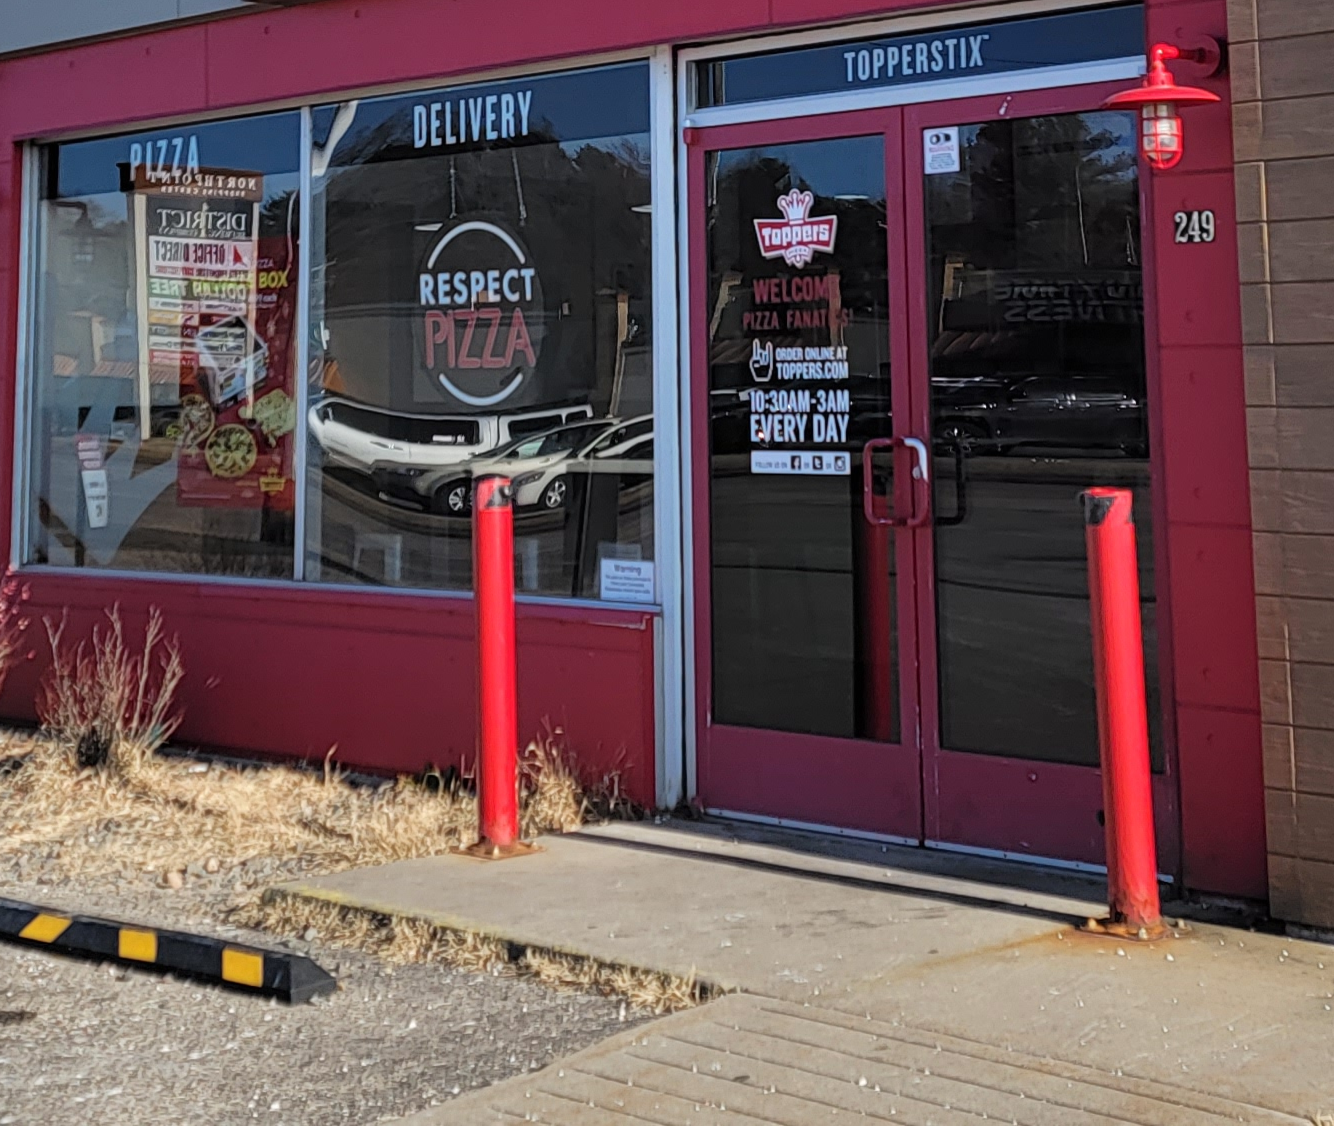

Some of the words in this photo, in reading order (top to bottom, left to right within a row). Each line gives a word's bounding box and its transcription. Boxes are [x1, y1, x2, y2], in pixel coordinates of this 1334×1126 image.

[413, 90, 532, 149] DELIVERY
[130, 135, 199, 181] PIZZA
[761, 224, 830, 247] Toppers
[1174, 210, 1215, 243] 249
[258, 271, 288, 289] BOX
[419, 268, 535, 305] RESPECT
[743, 312, 779, 330] PIZZA
[424, 307, 536, 369] PIZZA
[775, 347, 803, 361] ORDER
[805, 347, 835, 361] ONLINE
[836, 346, 848, 360] AT
[775, 361, 849, 380] TOPPERS.COM
[750, 389, 849, 413] 10:30AM-3AM
[750, 413, 807, 443] EVERY
[813, 414, 849, 443] DAY
